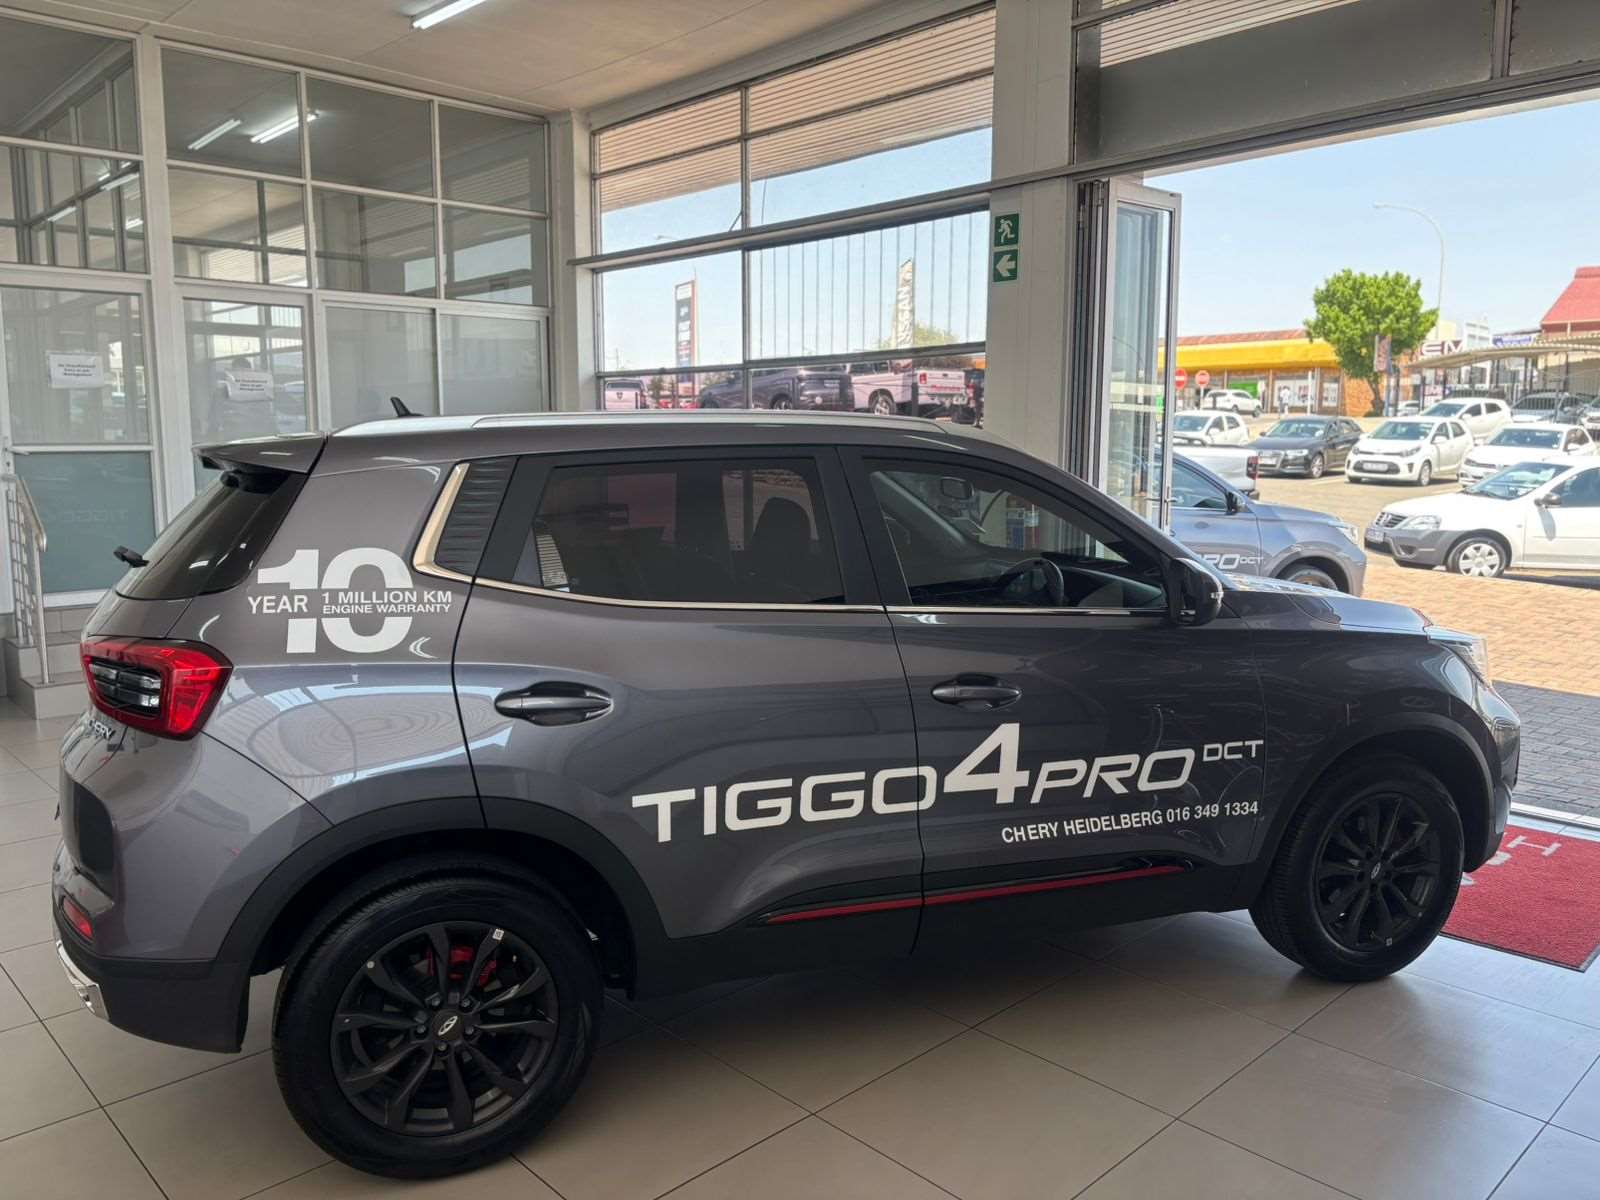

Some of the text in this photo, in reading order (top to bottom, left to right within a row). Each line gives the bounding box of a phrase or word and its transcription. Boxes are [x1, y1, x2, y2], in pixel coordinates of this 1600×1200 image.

[247, 594, 309, 615] YEAR
[257, 547, 414, 654] 10
[322, 590, 452, 604] 1 MILLION KM
[322, 603, 451, 615] ENGINE WARRANTY
[631, 722, 1265, 843] TIGGO 4 PRO DCT
[1001, 801, 1259, 844] CHERY HEIDELBERG 016 349 1334
